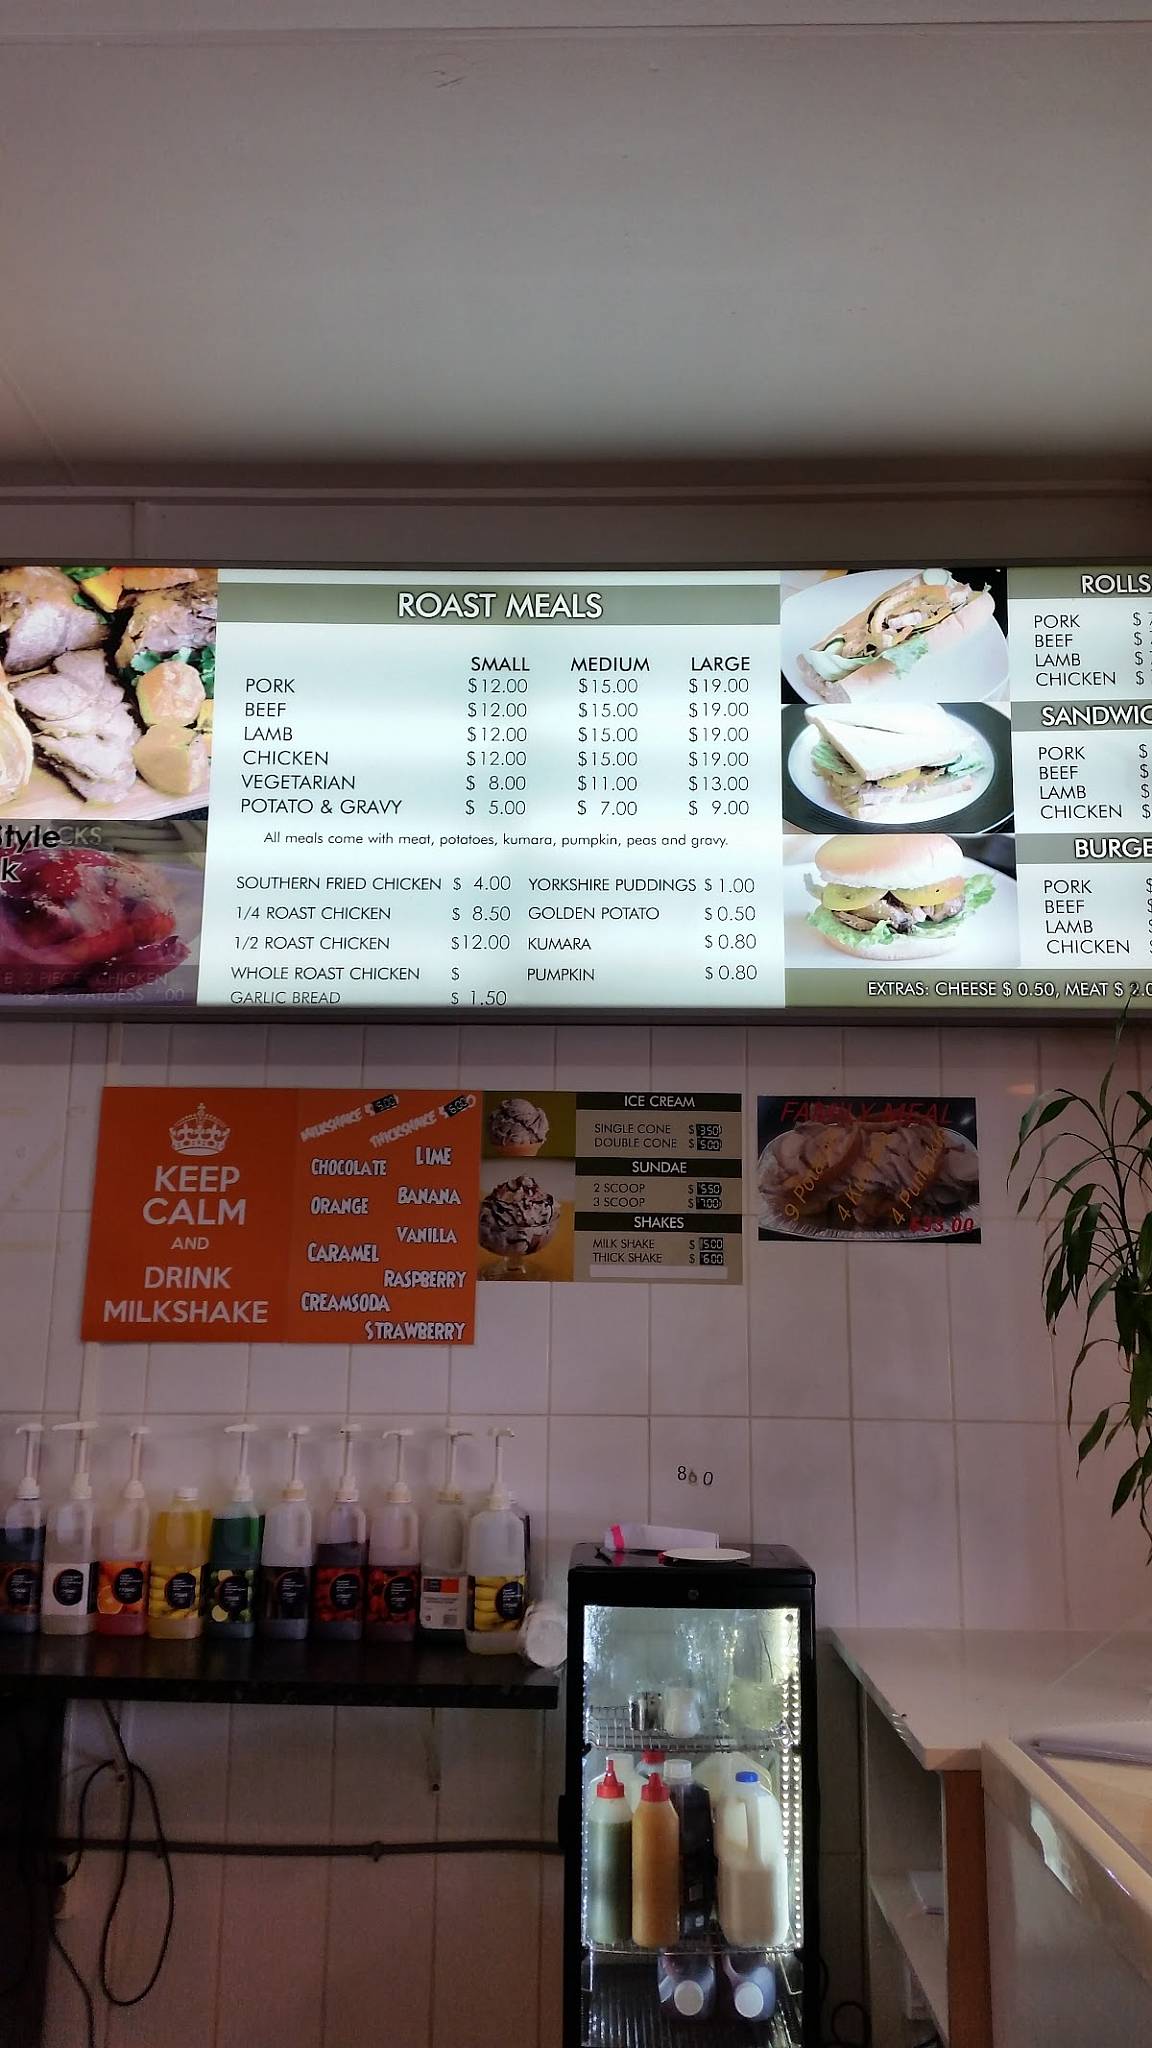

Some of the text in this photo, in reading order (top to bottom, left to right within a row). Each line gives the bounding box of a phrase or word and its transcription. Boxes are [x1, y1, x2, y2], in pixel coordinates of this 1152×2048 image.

[1081, 575, 1151, 593] ROLLS
[398, 593, 602, 618] ROAST MEALS
[1035, 615, 1080, 628] PORK
[1035, 634, 1072, 647] BEEF
[472, 657, 530, 671] SMALL
[571, 657, 649, 671] MEDIUM
[692, 657, 750, 671] LARGE
[1036, 653, 1080, 667] LAMB
[247, 679, 294, 693] PORK
[1036, 672, 1115, 686] CHICKEN
[246, 703, 286, 716] BEEF
[1041, 707, 1152, 726] SANDWIC
[245, 727, 292, 741] LAMB
[243, 751, 328, 765] CHICKEN
[1039, 746, 1085, 760] PORK
[1040, 766, 1078, 779] BEEF
[242, 775, 354, 789] VEGETARIAN
[1040, 785, 1086, 799] LAMB
[242, 799, 402, 814] POTATO & GRAVY
[1041, 805, 1122, 819] CHICKEN
[0, 825, 60, 854] tyle
[264, 832, 280, 842] All
[286, 832, 323, 843] meals
[368, 832, 393, 843] with
[399, 835, 434, 846] meat,
[440, 835, 497, 847] potatoes,
[504, 833, 556, 846] kumara,
[562, 834, 620, 847] pumpkin,
[628, 838, 656, 848] peas
[662, 834, 685, 845] and
[692, 838, 727, 848] gravy.
[1075, 839, 1152, 858] BURGE
[237, 877, 441, 890] SOUTHERN FRIED CHICKEN
[529, 878, 696, 891] YORKSHIRE PUDDINGS
[1044, 880, 1092, 893] PORK
[238, 907, 390, 920] 1/4 ROAST CHICKEN
[529, 907, 659, 920] GOLDEN POTATO
[1045, 900, 1084, 913] BEEF
[1046, 920, 1093, 933] LAMB
[235, 937, 389, 950] 1/2 ROAST CHICKEN
[529, 938, 591, 950] KUMARA
[1047, 940, 1129, 954] CHICKEN
[231, 967, 419, 980] WHOLE ROAST CHICKEN
[452, 968, 459, 980] $
[528, 968, 594, 981] PUMPKIN
[868, 982, 928, 996] EXTRAS:
[936, 982, 996, 996] CHEESE
[1066, 983, 1108, 996] MEAT
[230, 990, 340, 1005] GARLIC BREAD
[624, 1096, 695, 1108] ICE CREAM
[595, 1124, 634, 1135] SINGLE
[637, 1124, 671, 1135] CONE
[594, 1138, 639, 1149] DOUBLE
[643, 1138, 677, 1149] CONE
[416, 1147, 452, 1166] LIME
[311, 1159, 387, 1176] CHOCOLATE
[632, 1161, 687, 1174] SUNDAE
[155, 1166, 240, 1192] KEEP
[397, 1186, 461, 1205] BANANA
[594, 1183, 601, 1193] 2
[605, 1183, 645, 1194] SCOOP
[311, 1197, 369, 1215] ORANGE
[594, 1197, 600, 1208] 3
[605, 1197, 645, 1208] SCOOP
[143, 1198, 246, 1225] CALM
[634, 1215, 684, 1229] SHAKES
[396, 1226, 457, 1244] VANILLA
[171, 1237, 209, 1249] AND
[593, 1239, 618, 1249] MILK
[621, 1239, 655, 1249] SHAKE
[307, 1244, 379, 1263] CARAMEL
[593, 1252, 625, 1263] THICK
[627, 1253, 662, 1264] SHAKE
[144, 1267, 232, 1289] DRINK
[383, 1270, 467, 1289] RASPBERRY
[301, 1292, 390, 1312] CREAMSODA
[104, 1301, 269, 1323] MILKSHAKE
[364, 1321, 465, 1340] STRAWBERRY
